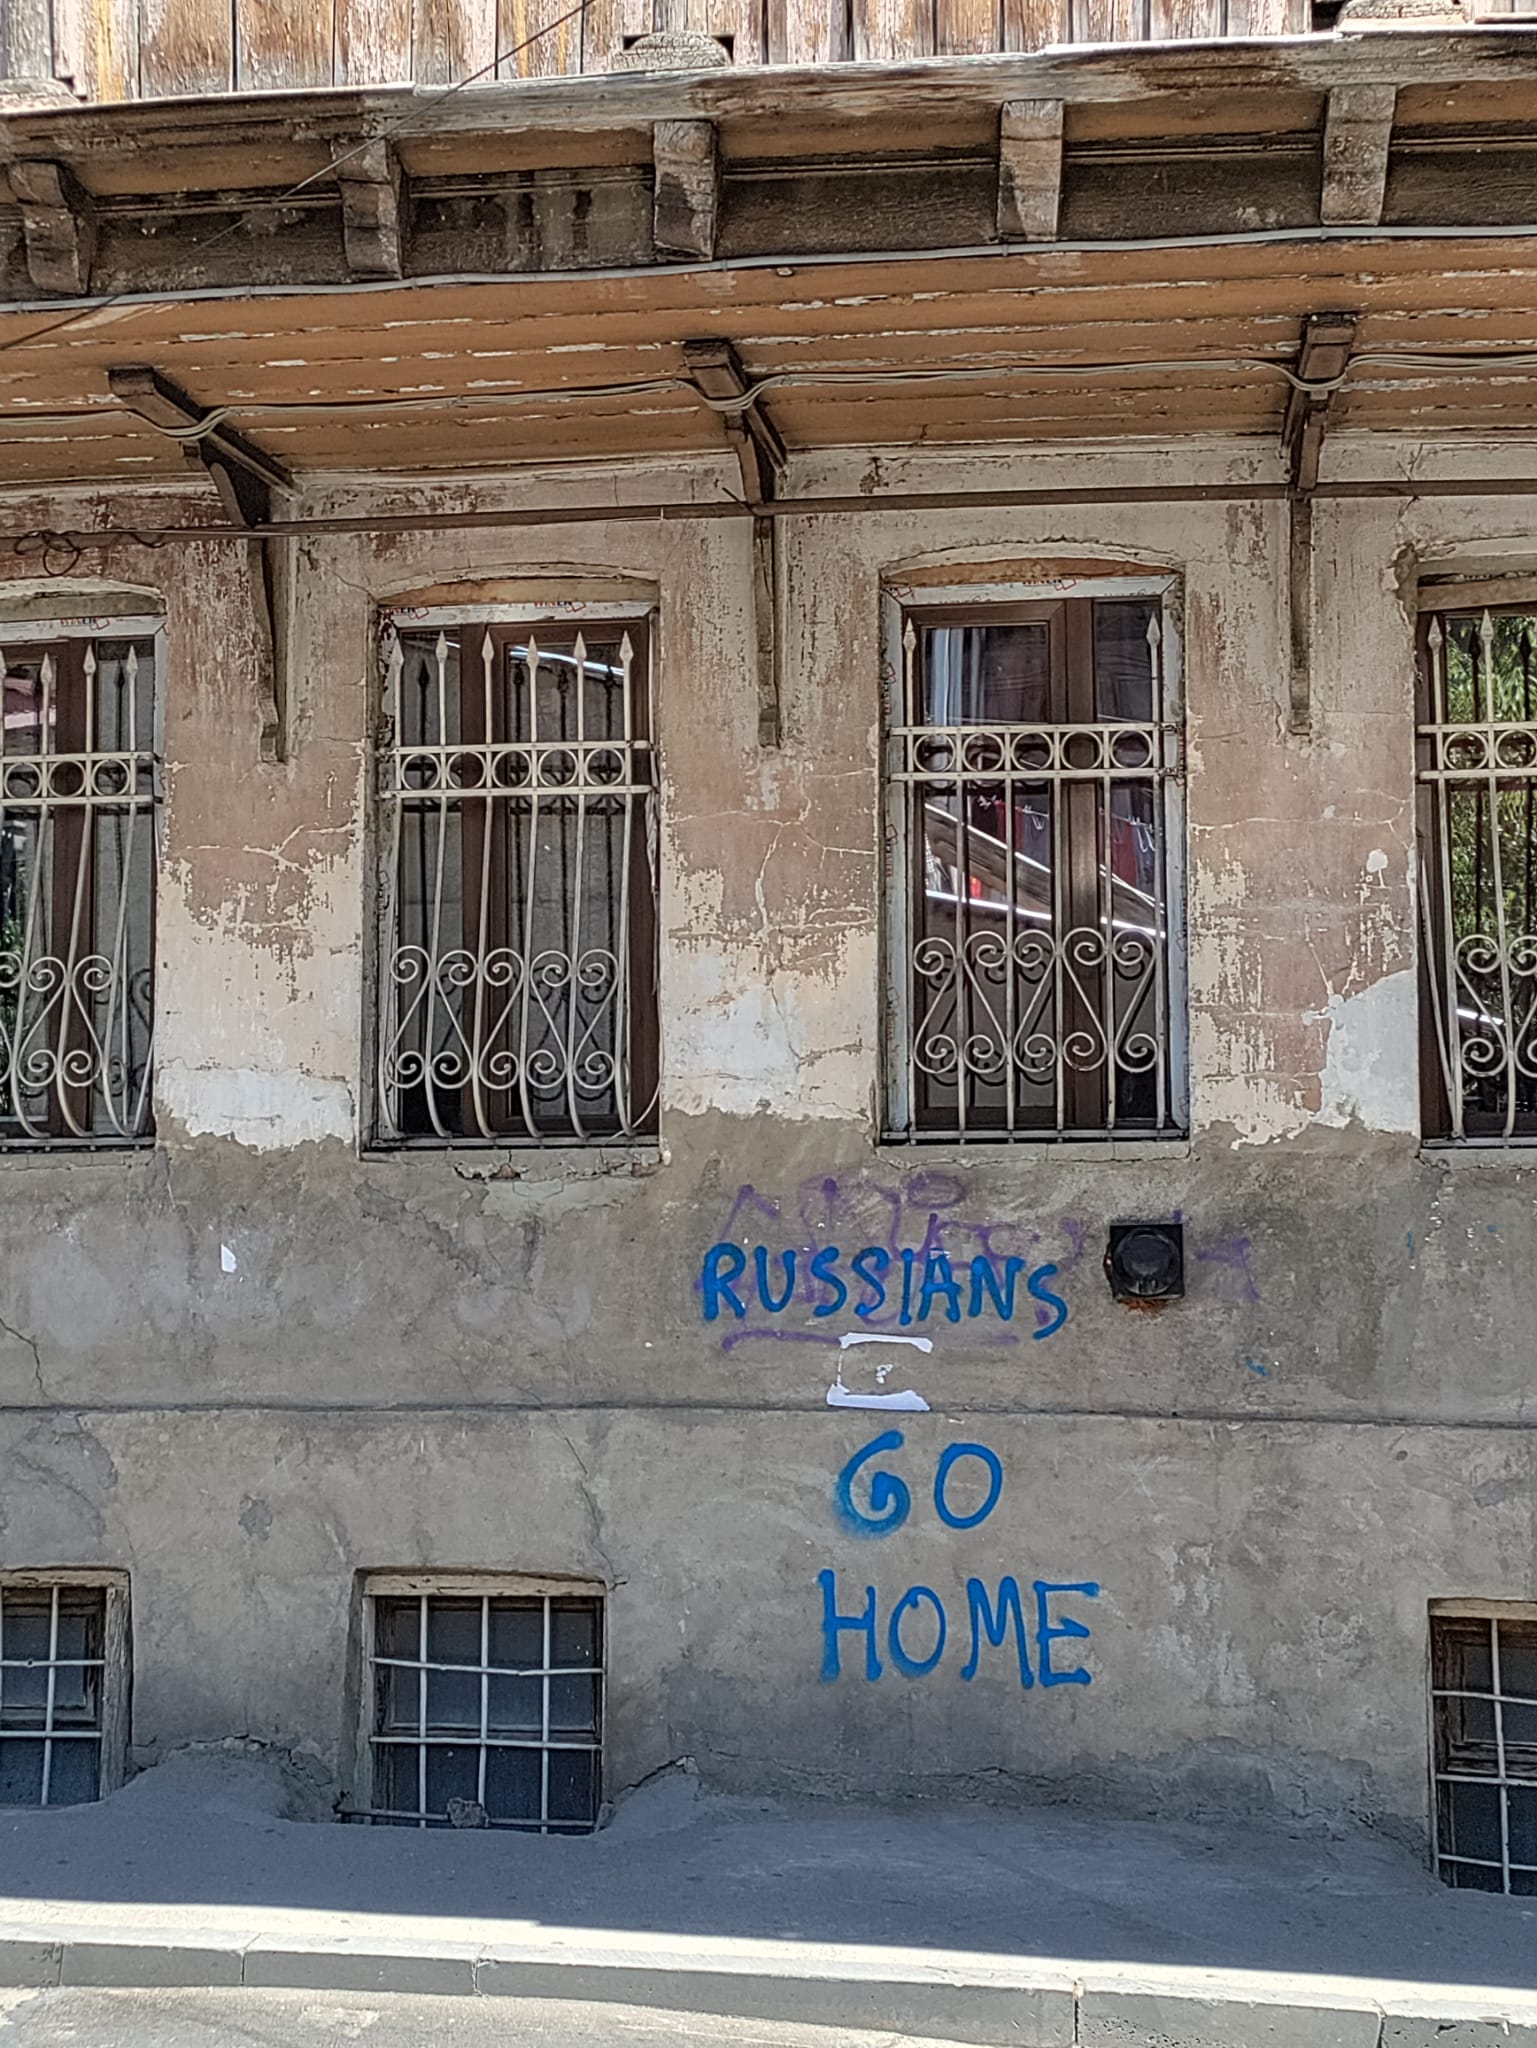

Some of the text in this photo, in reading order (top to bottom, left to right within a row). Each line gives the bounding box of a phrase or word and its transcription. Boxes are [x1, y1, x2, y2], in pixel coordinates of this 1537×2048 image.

[700, 1242, 1068, 1339] RUSSIANS
[834, 1429, 1004, 1537] GO
[817, 1568, 1100, 1689] HOME
